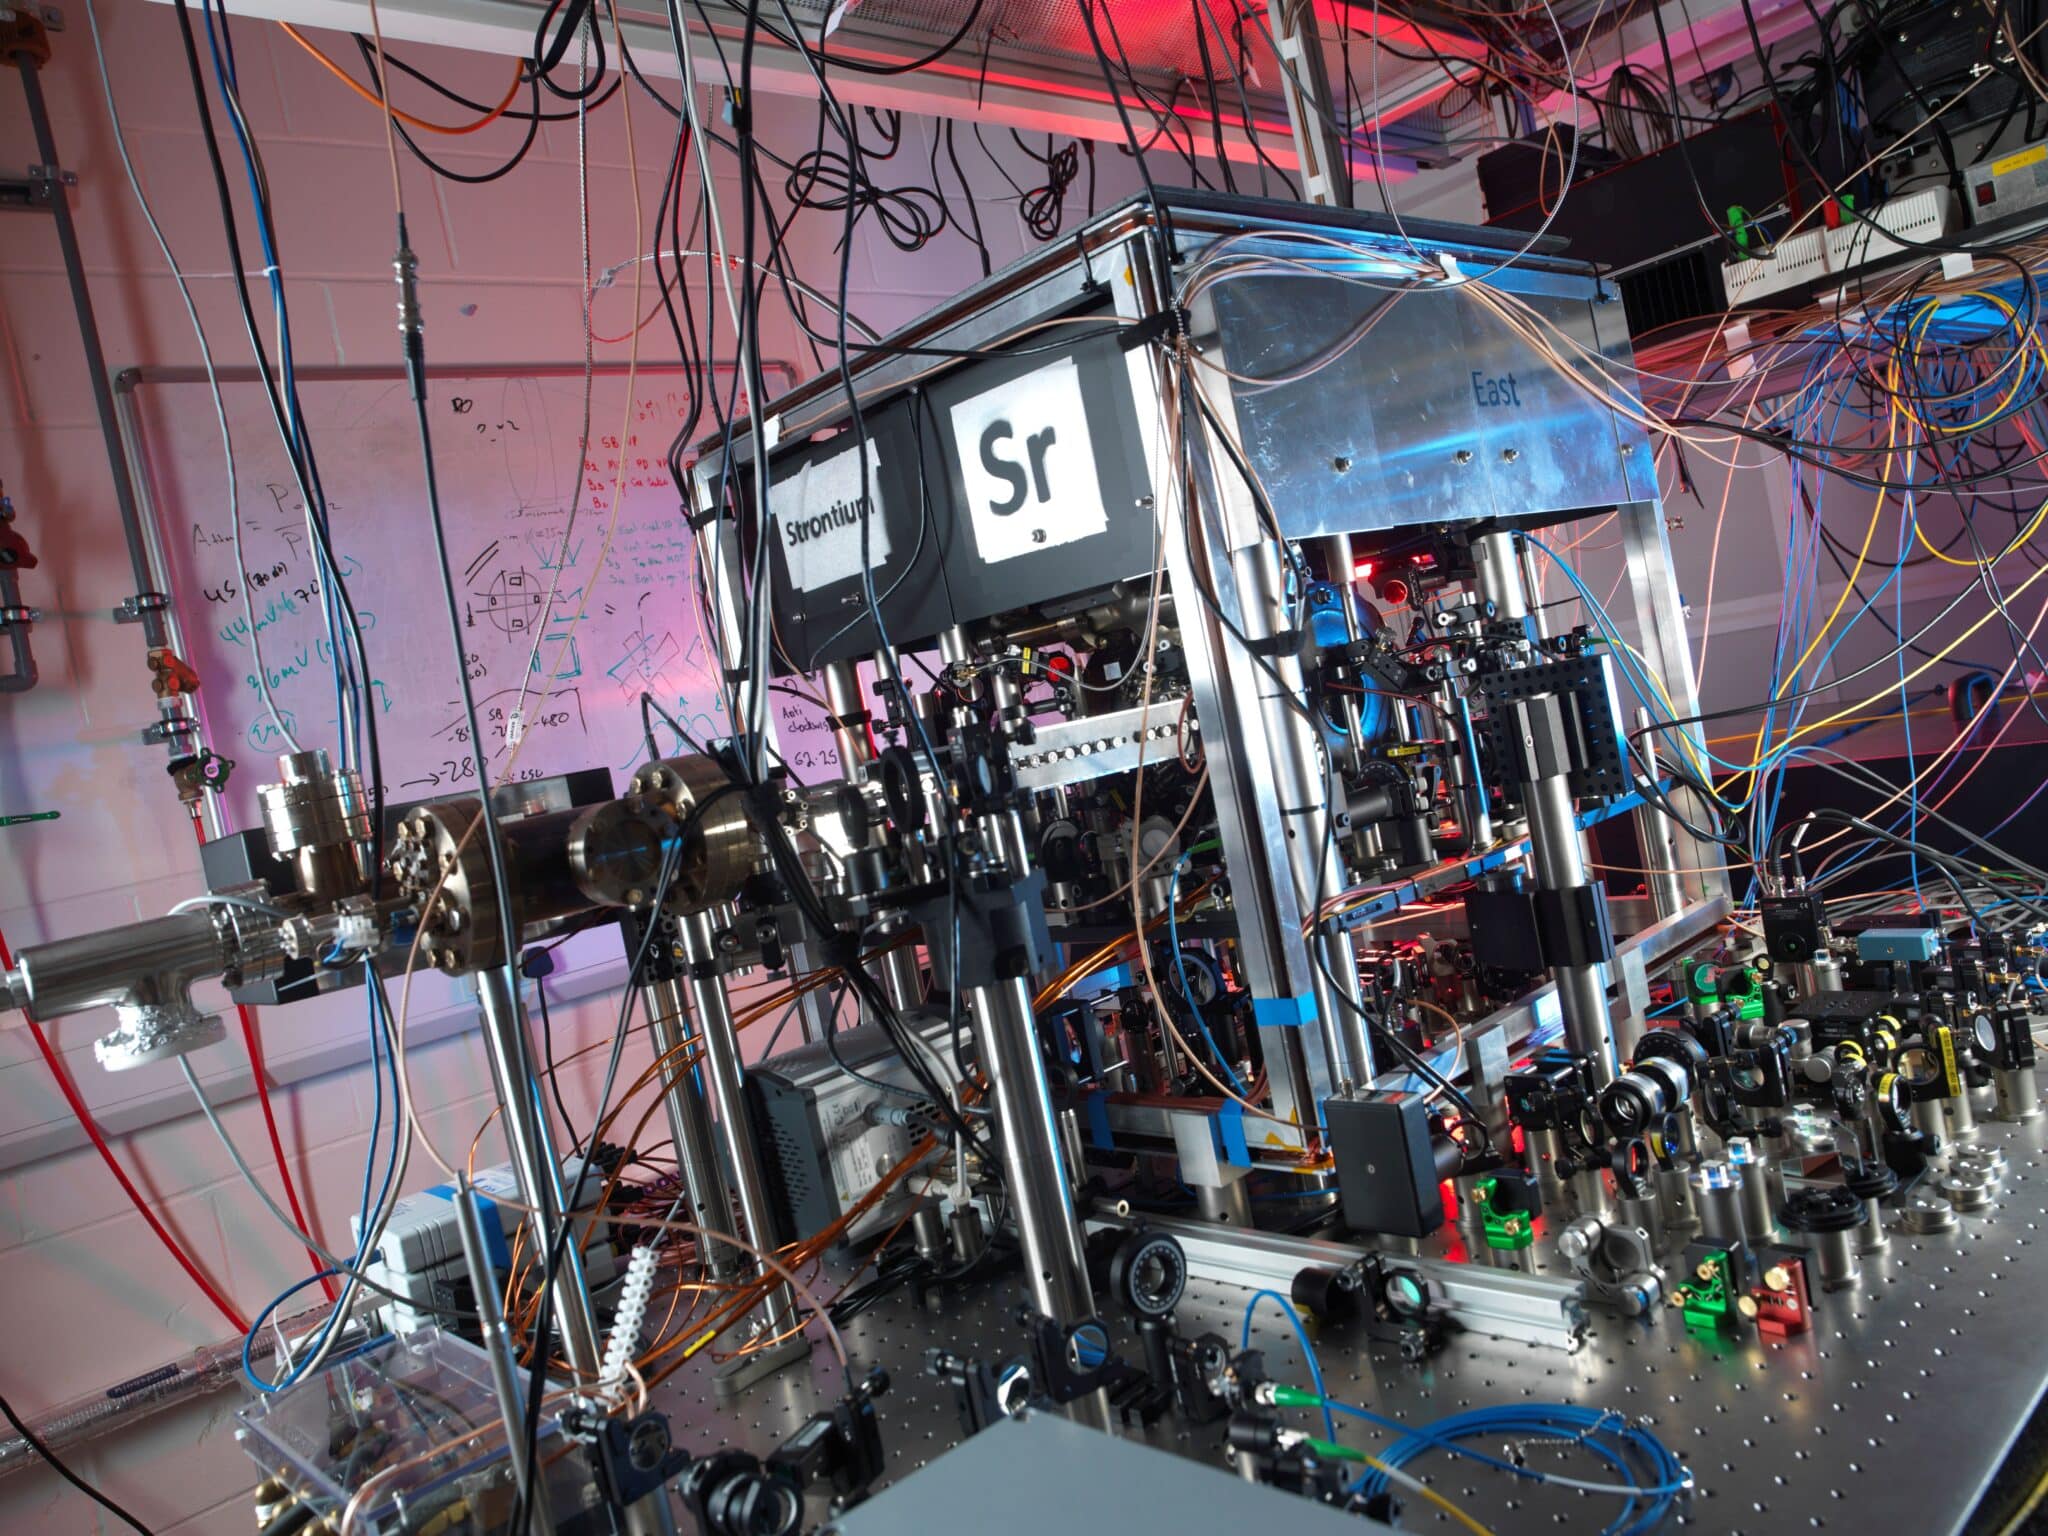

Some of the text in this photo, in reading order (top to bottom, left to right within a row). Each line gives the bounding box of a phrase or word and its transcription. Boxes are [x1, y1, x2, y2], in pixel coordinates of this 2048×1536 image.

[1472, 371, 1520, 407] East
[980, 419, 1056, 516] Sr
[786, 496, 875, 546] Strontium
[782, 704, 803, 719] Anti
[788, 717, 829, 733] clockwis
